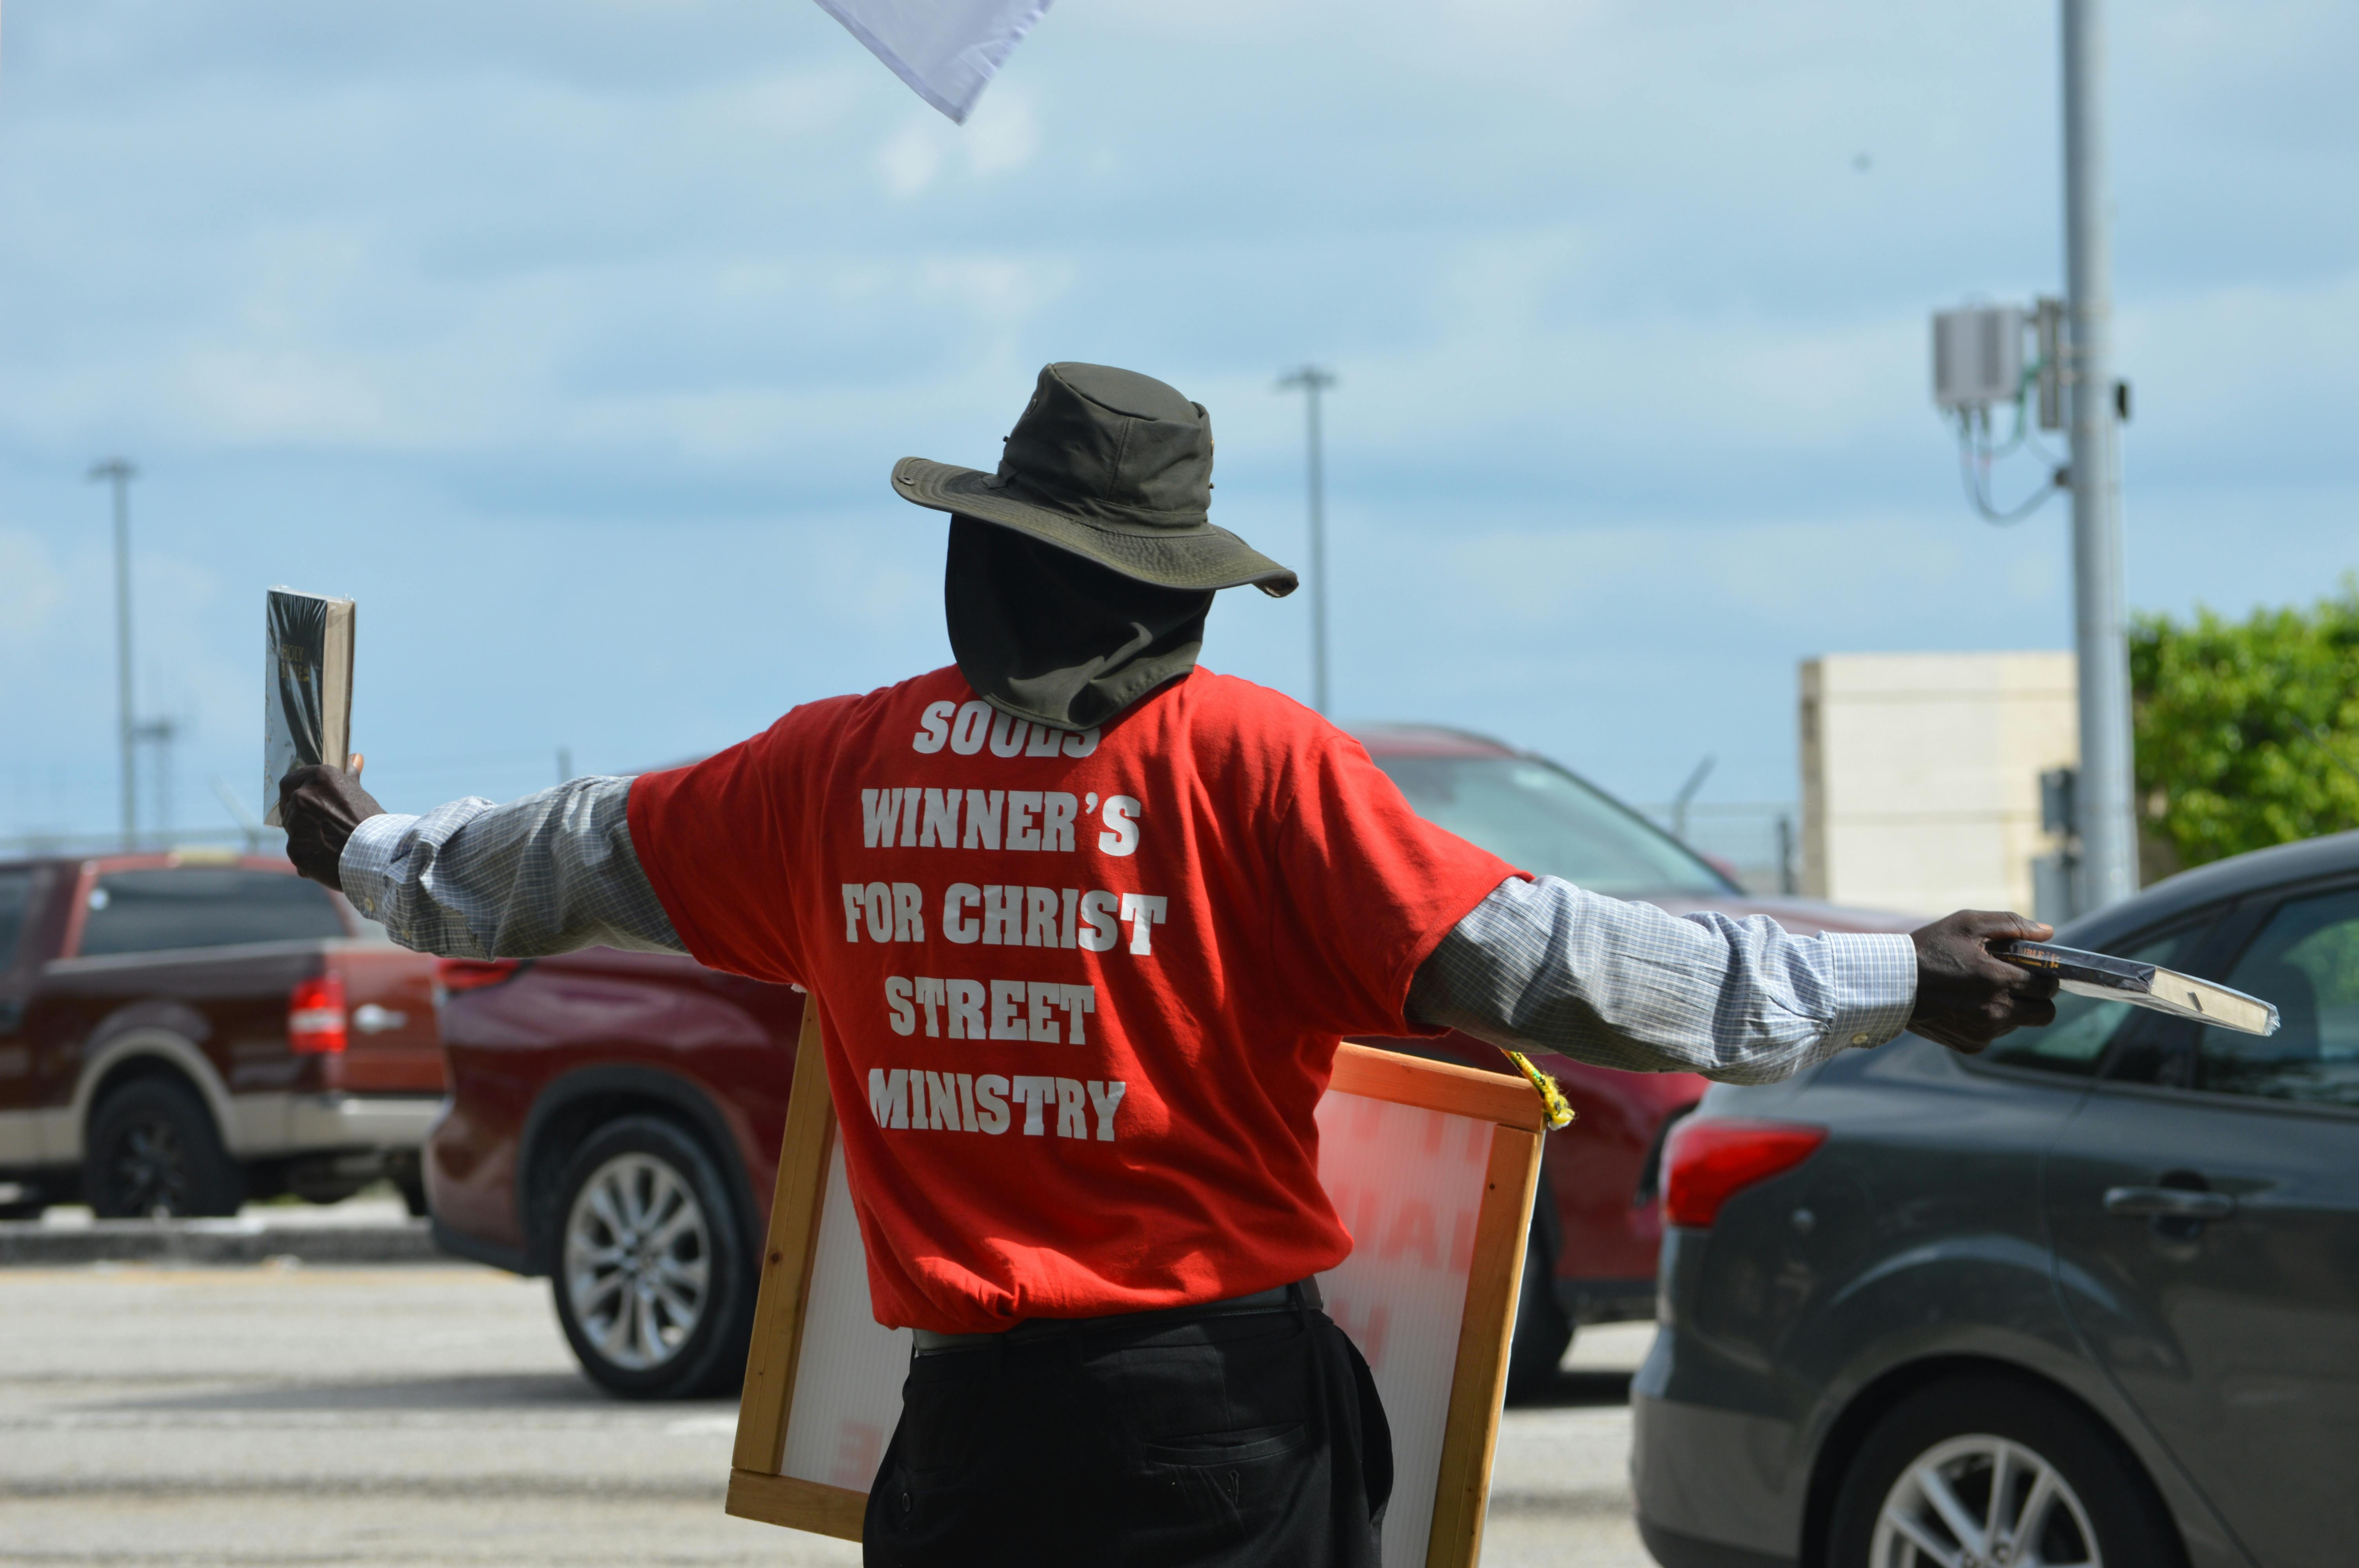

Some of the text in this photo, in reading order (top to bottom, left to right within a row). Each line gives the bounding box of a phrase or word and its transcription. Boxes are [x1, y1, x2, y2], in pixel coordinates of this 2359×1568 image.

[282, 643, 304, 662] HOLY
[861, 788, 1141, 857] WINNER'S
[842, 882, 1168, 956] FOR CHRIST
[885, 976, 1095, 1045] STREET
[868, 1068, 1126, 1142] MINISTRY
